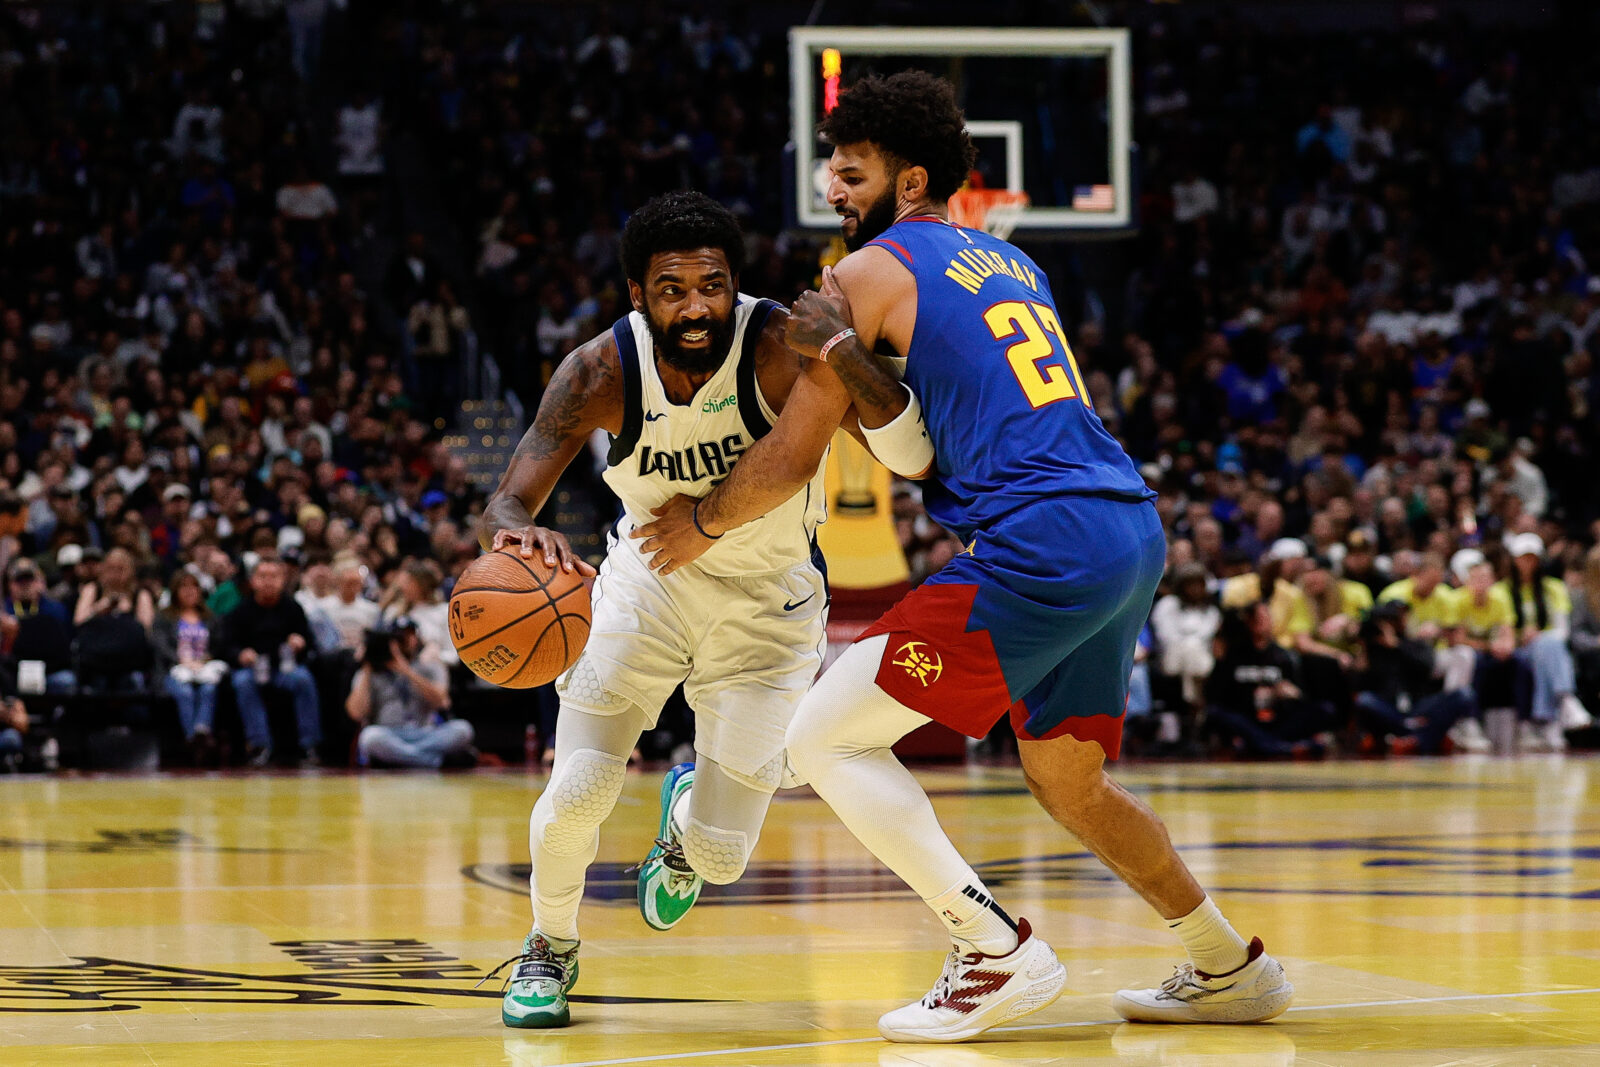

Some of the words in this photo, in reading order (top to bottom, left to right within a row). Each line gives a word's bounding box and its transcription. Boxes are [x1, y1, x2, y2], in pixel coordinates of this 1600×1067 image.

[944, 248, 1039, 295] MURRAY
[981, 300, 1092, 411] 27
[702, 394, 737, 414] chime
